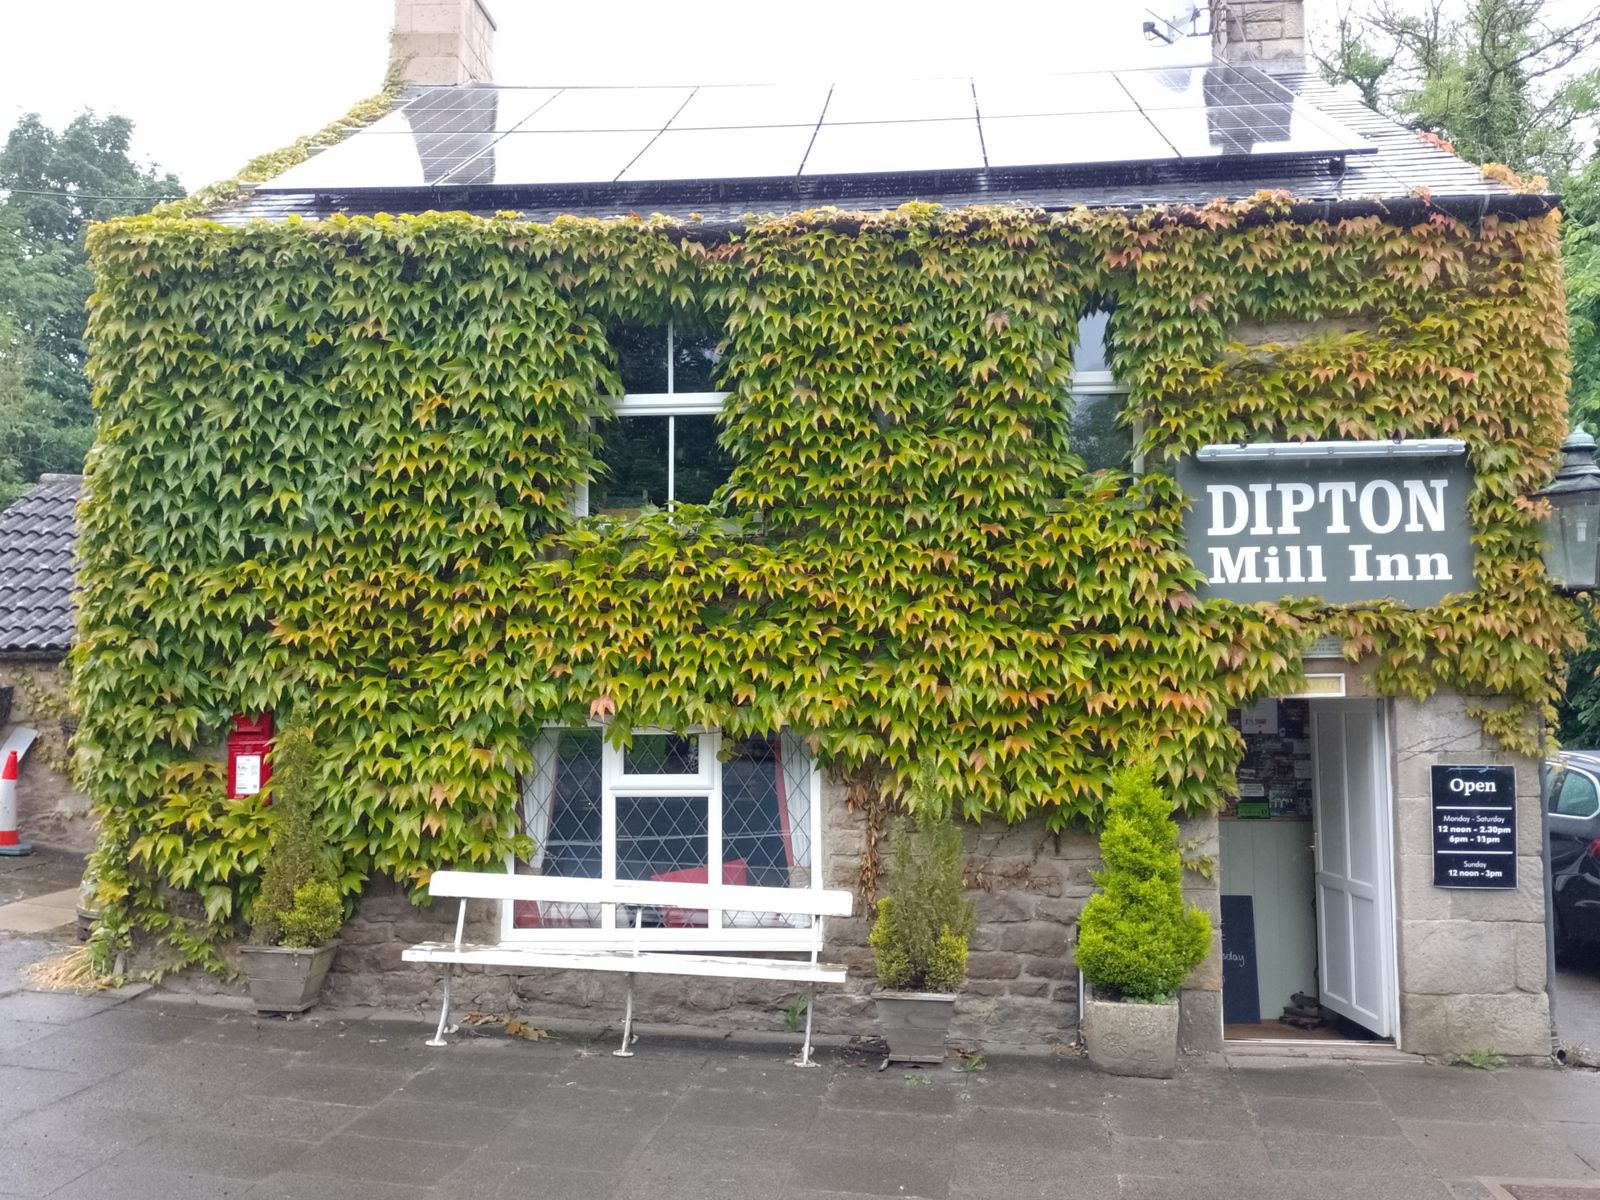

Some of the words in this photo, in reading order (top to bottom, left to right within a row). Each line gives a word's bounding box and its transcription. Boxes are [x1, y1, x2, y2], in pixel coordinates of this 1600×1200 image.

[1206, 479, 1449, 536] DIPTON
[1208, 546, 1327, 584] Mill
[1348, 544, 1453, 582] Inn
[1450, 778, 1497, 796] Open
[1443, 815, 1470, 823] Monday
[1476, 815, 1505, 824] Saturday
[1438, 825, 1448, 833] 12
[1479, 826, 1511, 834] 2.30pm
[1449, 835, 1468, 844] 6pm
[1477, 835, 1500, 844] 11pm
[1463, 860, 1487, 869] Sunday
[1448, 869, 1458, 877] 12
[1485, 870, 1503, 878] 3pm
